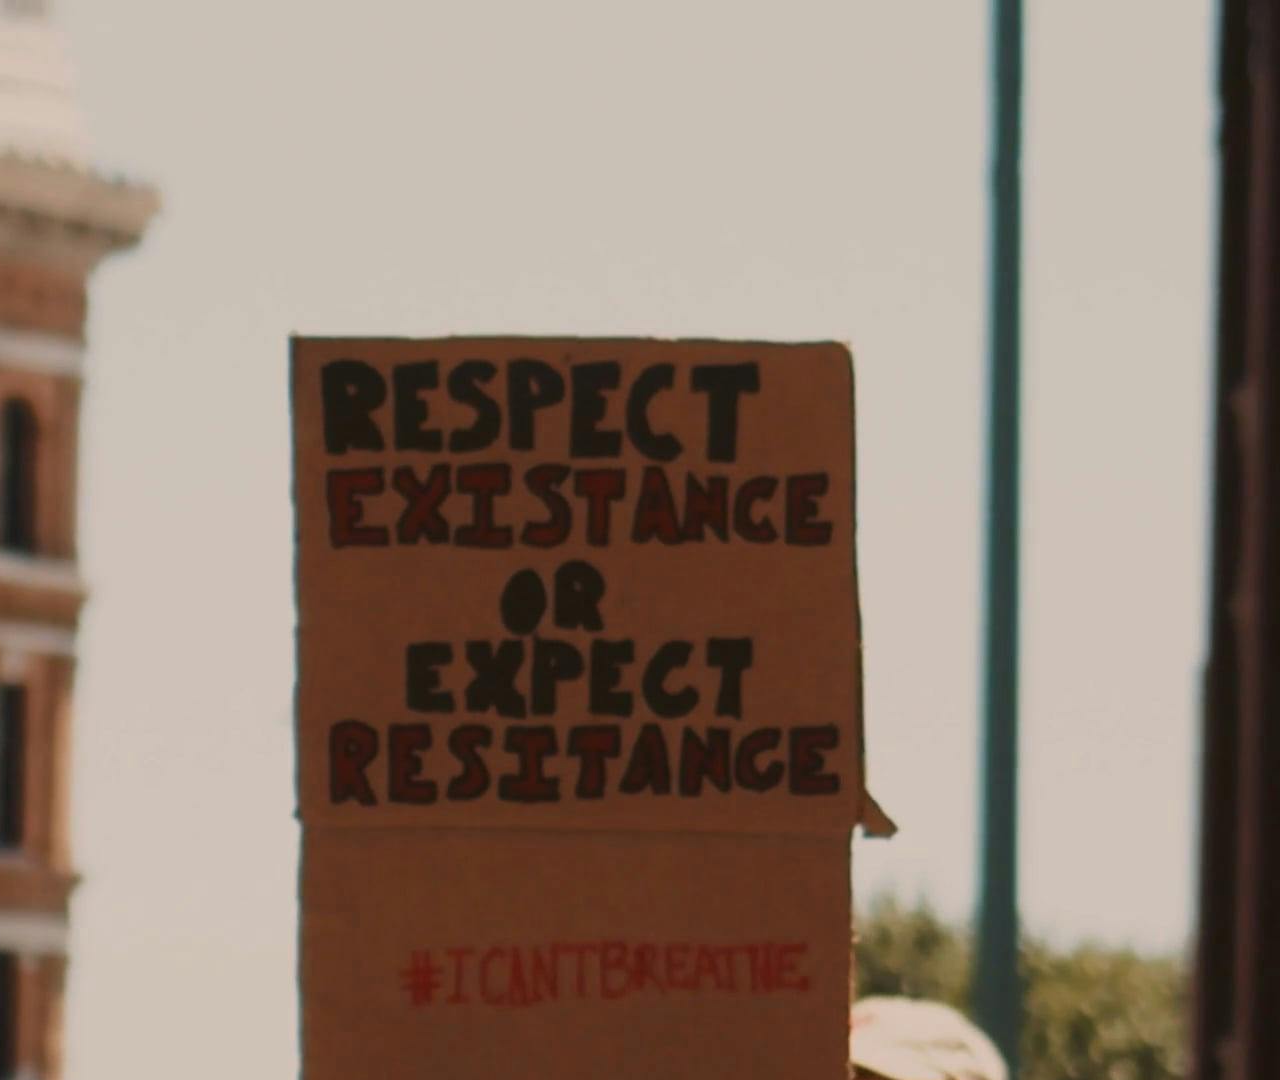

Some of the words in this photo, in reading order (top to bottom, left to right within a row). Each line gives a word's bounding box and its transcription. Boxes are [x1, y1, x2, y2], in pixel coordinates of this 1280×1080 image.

[322, 359, 760, 462] RESPECT
[326, 463, 833, 549] EXISTANCE
[500, 560, 606, 635] OR
[406, 638, 752, 719] EXPECT
[329, 720, 840, 805] RESITANCE
